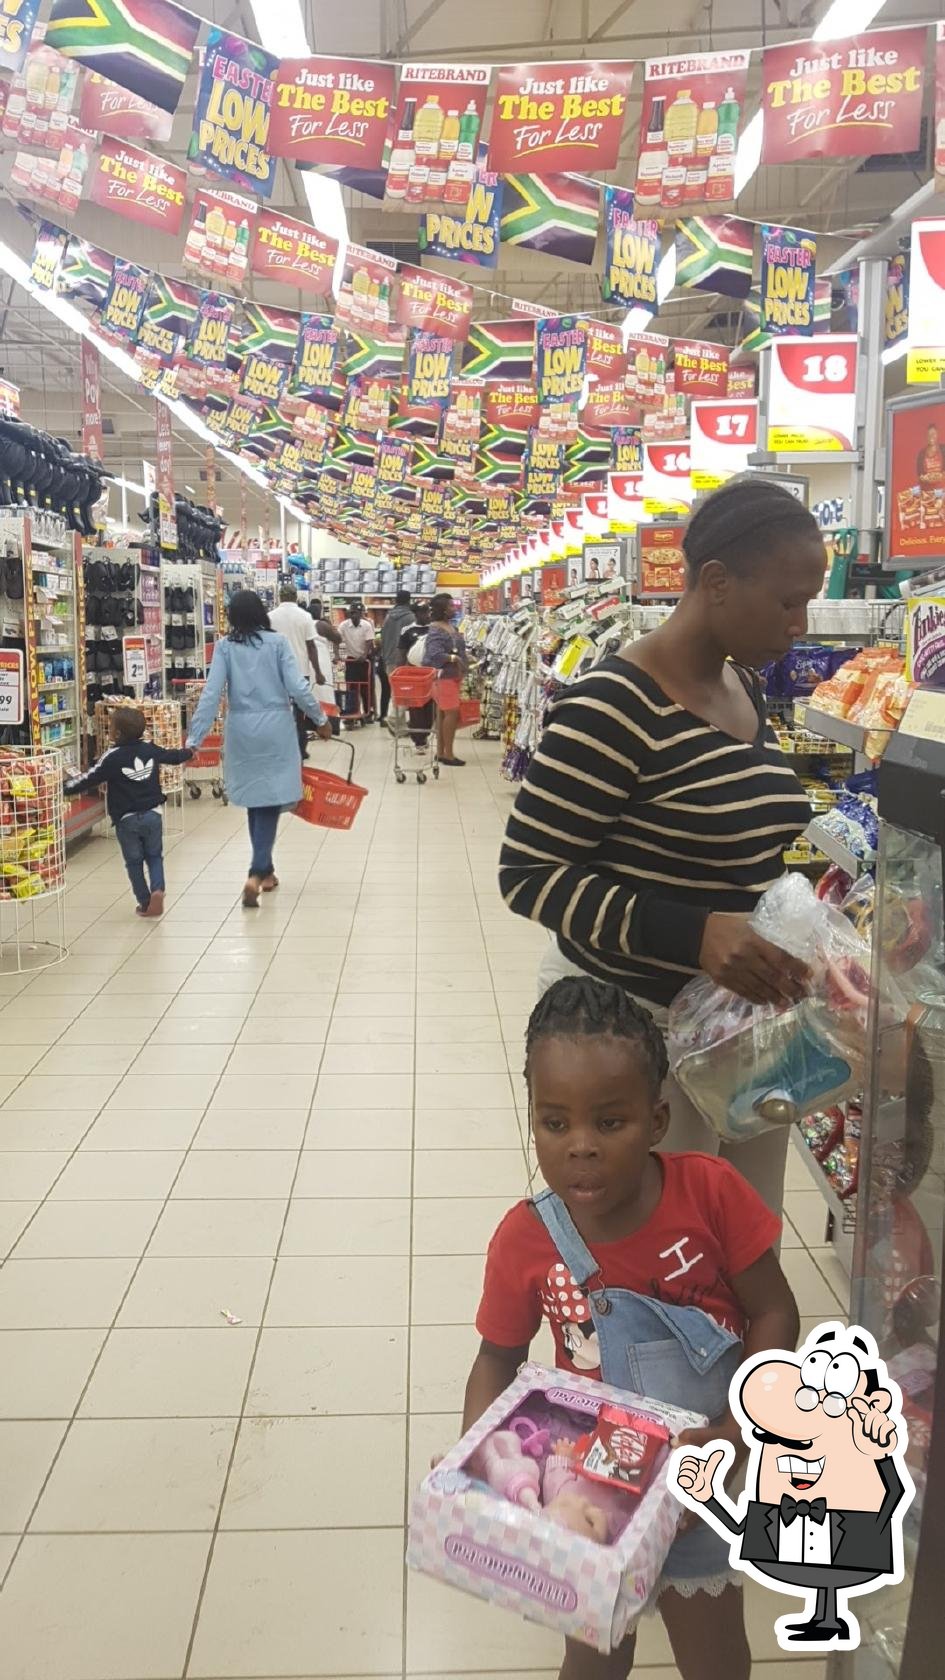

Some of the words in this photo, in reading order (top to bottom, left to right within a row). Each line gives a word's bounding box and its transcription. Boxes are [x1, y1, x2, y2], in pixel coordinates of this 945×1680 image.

[404, 67, 488, 83] RITEBRAND
[649, 54, 745, 78] RITEBRAND
[789, 54, 841, 78] Just
[843, 47, 899, 71] like
[212, 54, 275, 104] EASTE
[295, 68, 335, 89] Just
[338, 72, 375, 92] like
[519, 78, 565, 96] Just
[568, 76, 609, 94] like
[766, 78, 831, 109] The
[840, 63, 922, 98] Best
[206, 80, 271, 146] LOW
[276, 83, 326, 112] The
[330, 89, 389, 119] Best
[498, 94, 555, 121] The
[561, 91, 627, 120] Best
[786, 106, 831, 132] For
[834, 95, 896, 123] Less
[288, 114, 322, 137] For
[325, 111, 369, 138] Less
[513, 125, 552, 151] For
[554, 116, 603, 145] Less
[199, 119, 271, 180] PRICES
[100, 153, 138, 184] The
[142, 174, 185, 206] Best
[114, 150, 146, 171] Just
[148, 163, 175, 186] like
[108, 178, 135, 197] For
[135, 188, 171, 211] Less
[258, 226, 293, 252] The
[296, 239, 336, 267] Best
[270, 221, 300, 240] Just
[301, 232, 327, 250] like
[426, 211, 496, 256] PRICES
[266, 249, 290, 265] For
[292, 256, 322, 276] Less
[612, 230, 655, 274] LOW
[766, 243, 812, 268] EASTER
[609, 265, 656, 303] PRICES
[766, 264, 809, 300] LOW
[109, 284, 142, 312] LOW
[765, 296, 810, 326] PRICES
[198, 319, 228, 345] LOW
[542, 329, 585, 348] EASTER
[302, 342, 334, 367] LOW
[414, 351, 451, 379] LOW
[543, 346, 584, 374] LOW
[802, 354, 848, 383] 18
[248, 358, 283, 385] LOW
[298, 364, 332, 386] PRICES
[541, 372, 585, 397] PRICES
[243, 374, 279, 399] PRICES
[411, 378, 449, 398] PRICES
[489, 391, 513, 404] The
[715, 414, 749, 437] 17
[663, 452, 691, 472] 16
[25, 554, 36, 638] PRICES
[29, 644, 39, 699] LOW
